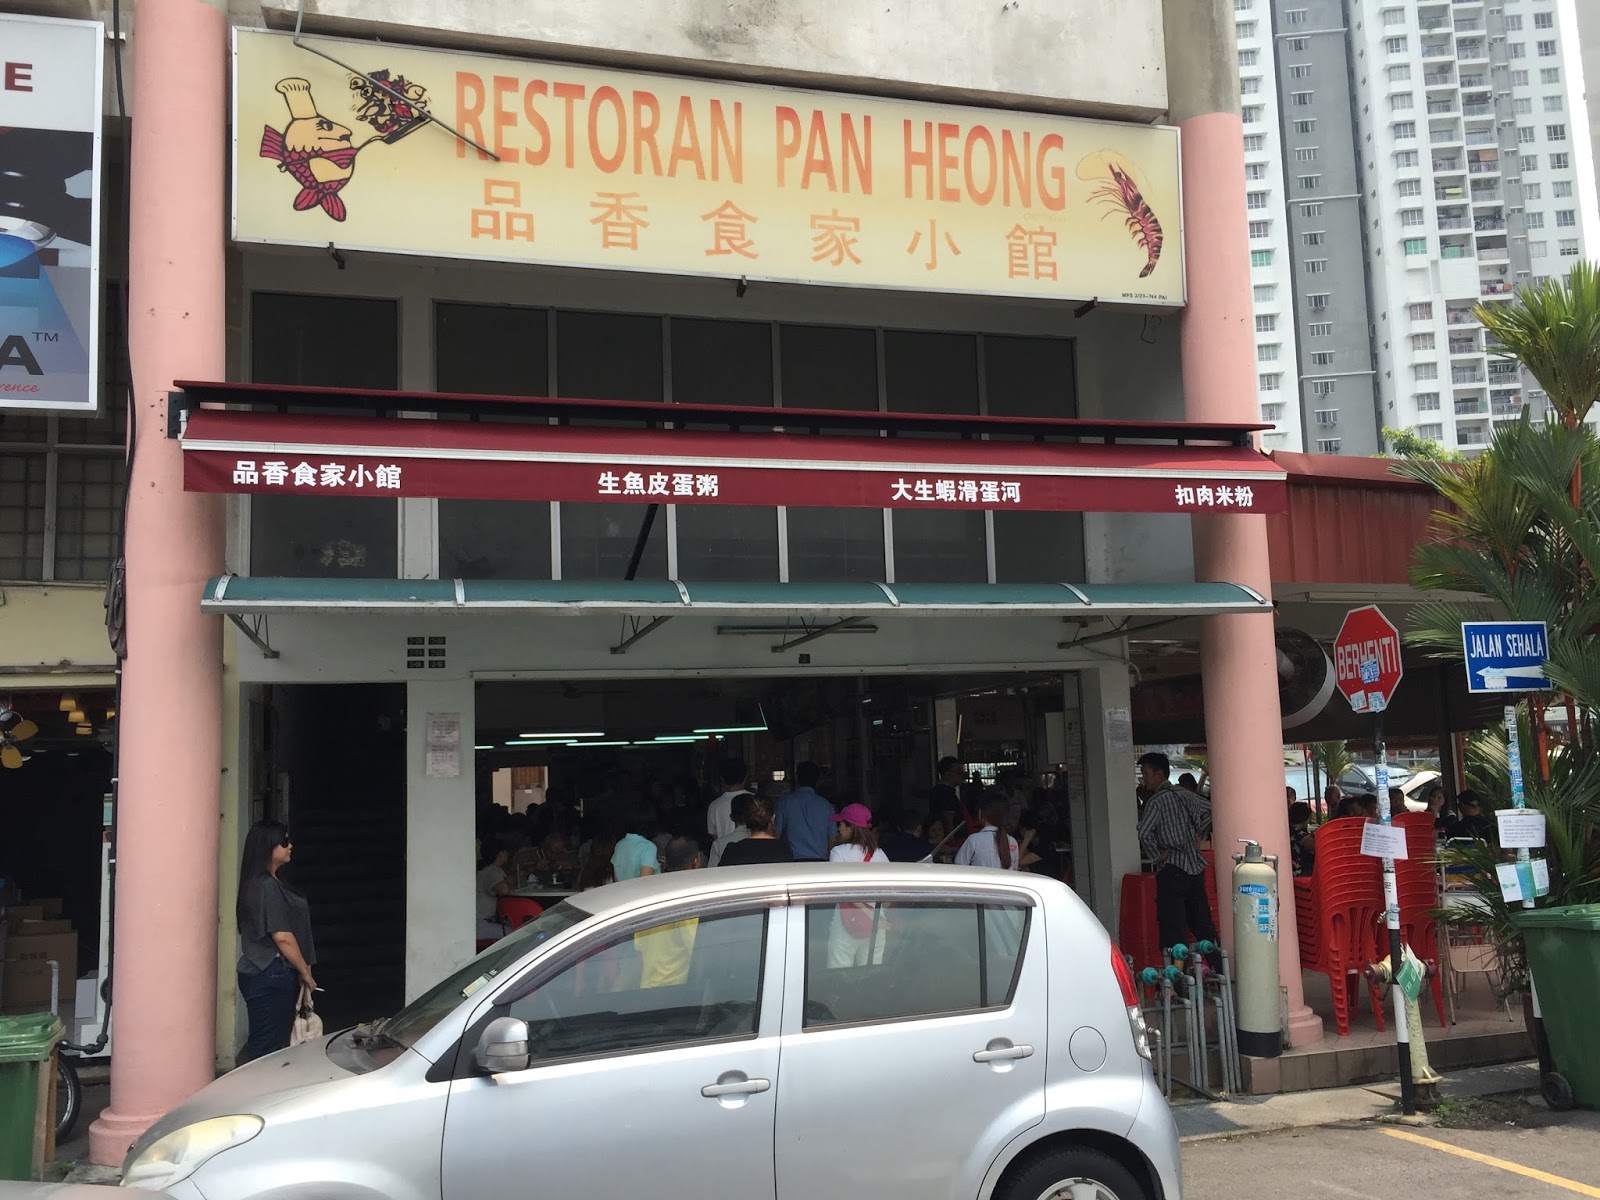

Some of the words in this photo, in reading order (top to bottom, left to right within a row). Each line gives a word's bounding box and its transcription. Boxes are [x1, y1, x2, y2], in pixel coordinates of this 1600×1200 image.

[4, 62, 33, 92] E
[455, 72, 743, 184] RESTORAN
[775, 106, 872, 196] PAN
[903, 119, 1066, 212] HEONG
[470, 178, 1058, 282] 品香食家小館
[233, 460, 402, 489] 品香食家小館
[598, 471, 719, 497] 生魚皮蛋粥
[891, 478, 1021, 503] 大生蝦滑蛋河
[1174, 484, 1254, 507] 扣肉米粉
[1337, 636, 1398, 681] BERHENTI
[1470, 634, 1503, 658] JALAN
[1506, 633, 1544, 658] SEHALA
